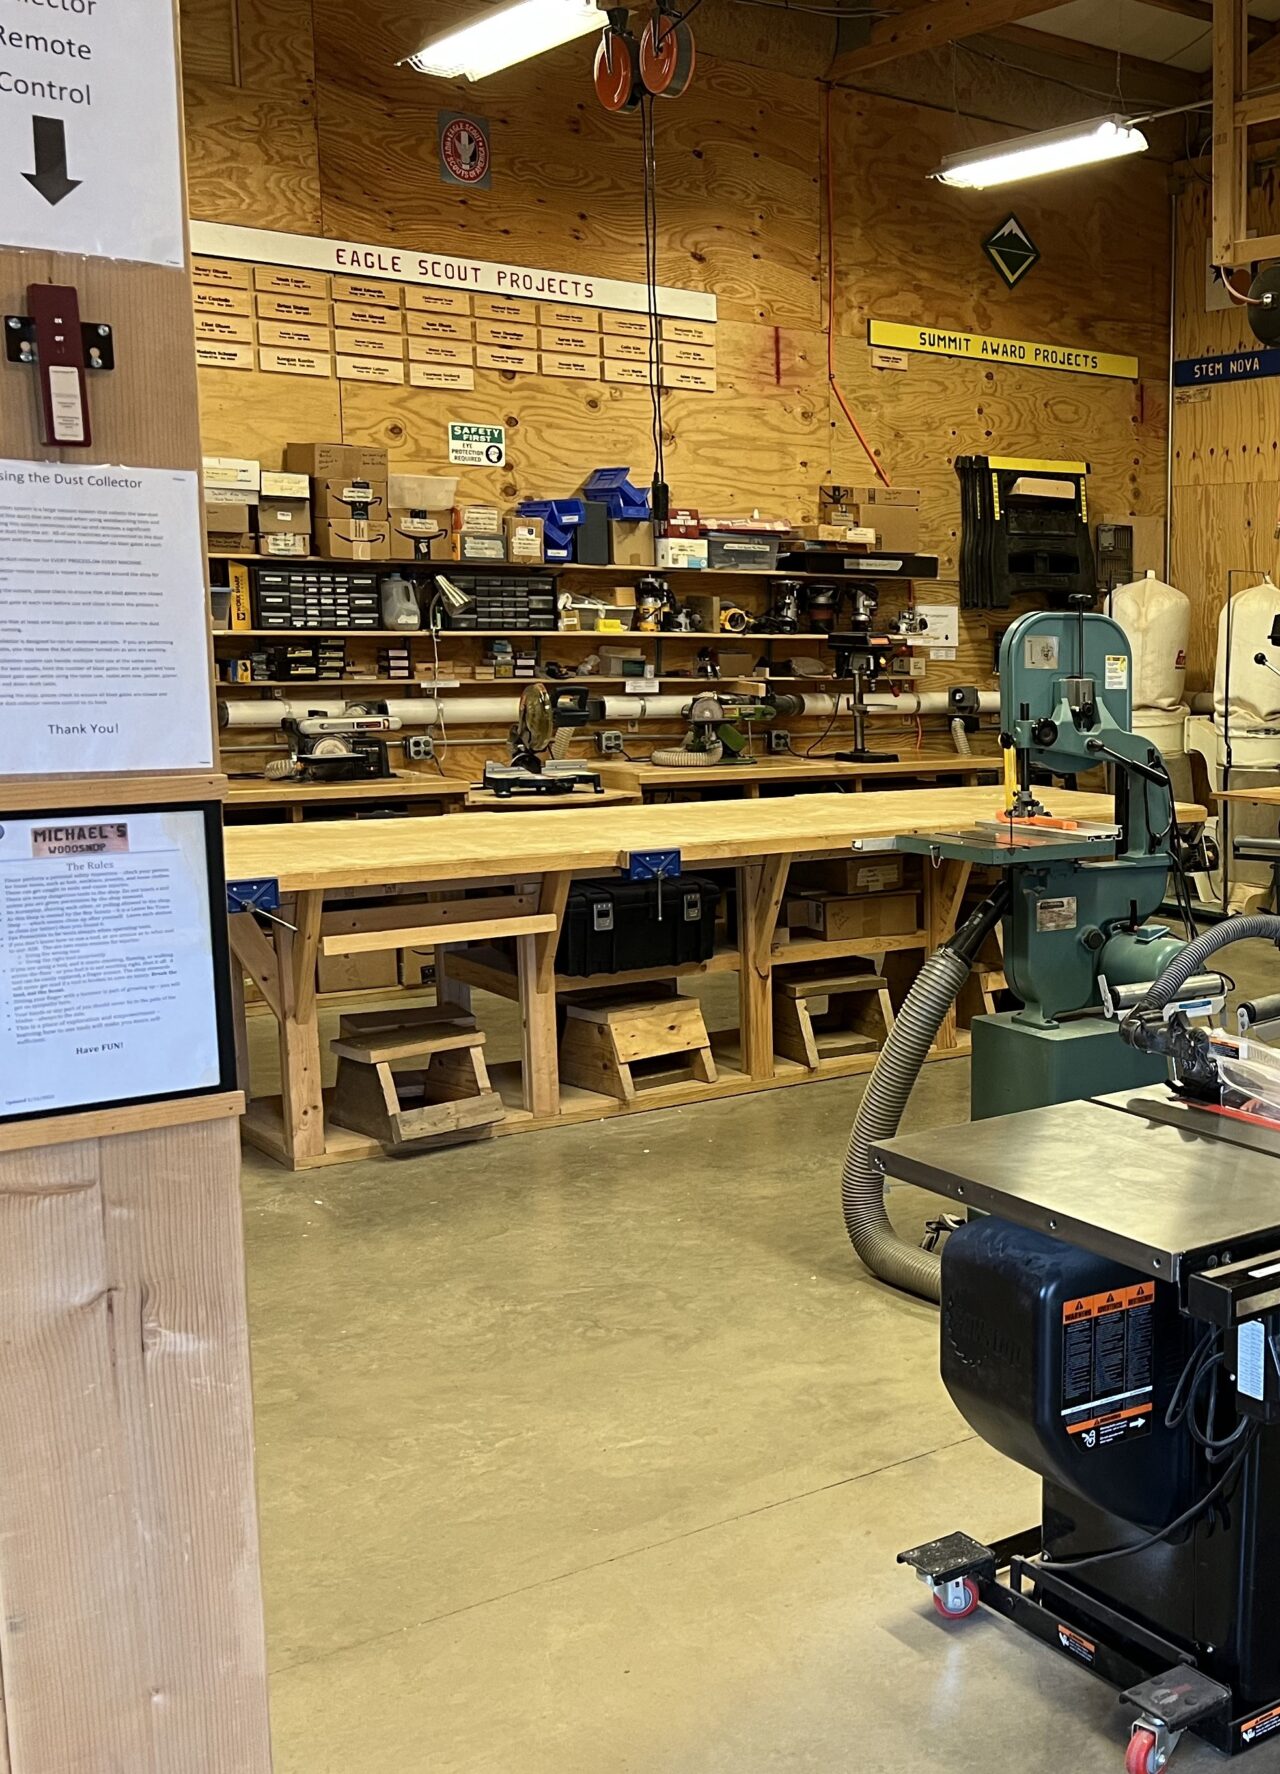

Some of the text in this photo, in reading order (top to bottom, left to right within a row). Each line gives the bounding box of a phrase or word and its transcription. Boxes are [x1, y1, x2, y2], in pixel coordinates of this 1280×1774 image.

[0, 71, 91, 105] Control
[336, 249, 594, 298] EAGLE SCOUT PROJECTS
[919, 332, 1098, 369] SUMMIT AWARD PROJECTS
[1193, 359, 1260, 378] STEM NOVA
[453, 426, 500, 438] SAFETY
[462, 434, 491, 443] FIRST
[451, 448, 484, 456] PROTECTION
[453, 455, 482, 463] REQUIRED
[28, 472, 50, 484] the
[54, 473, 84, 486] Dust
[87, 475, 143, 489] Collector
[48, 723, 119, 735] Thank You!
[33, 825, 127, 843] MICHAEL'S
[48, 843, 107, 854] WOODSHOP
[66, 861, 114, 872] The Rules
[75, 1041, 124, 1055] Have FUN!
